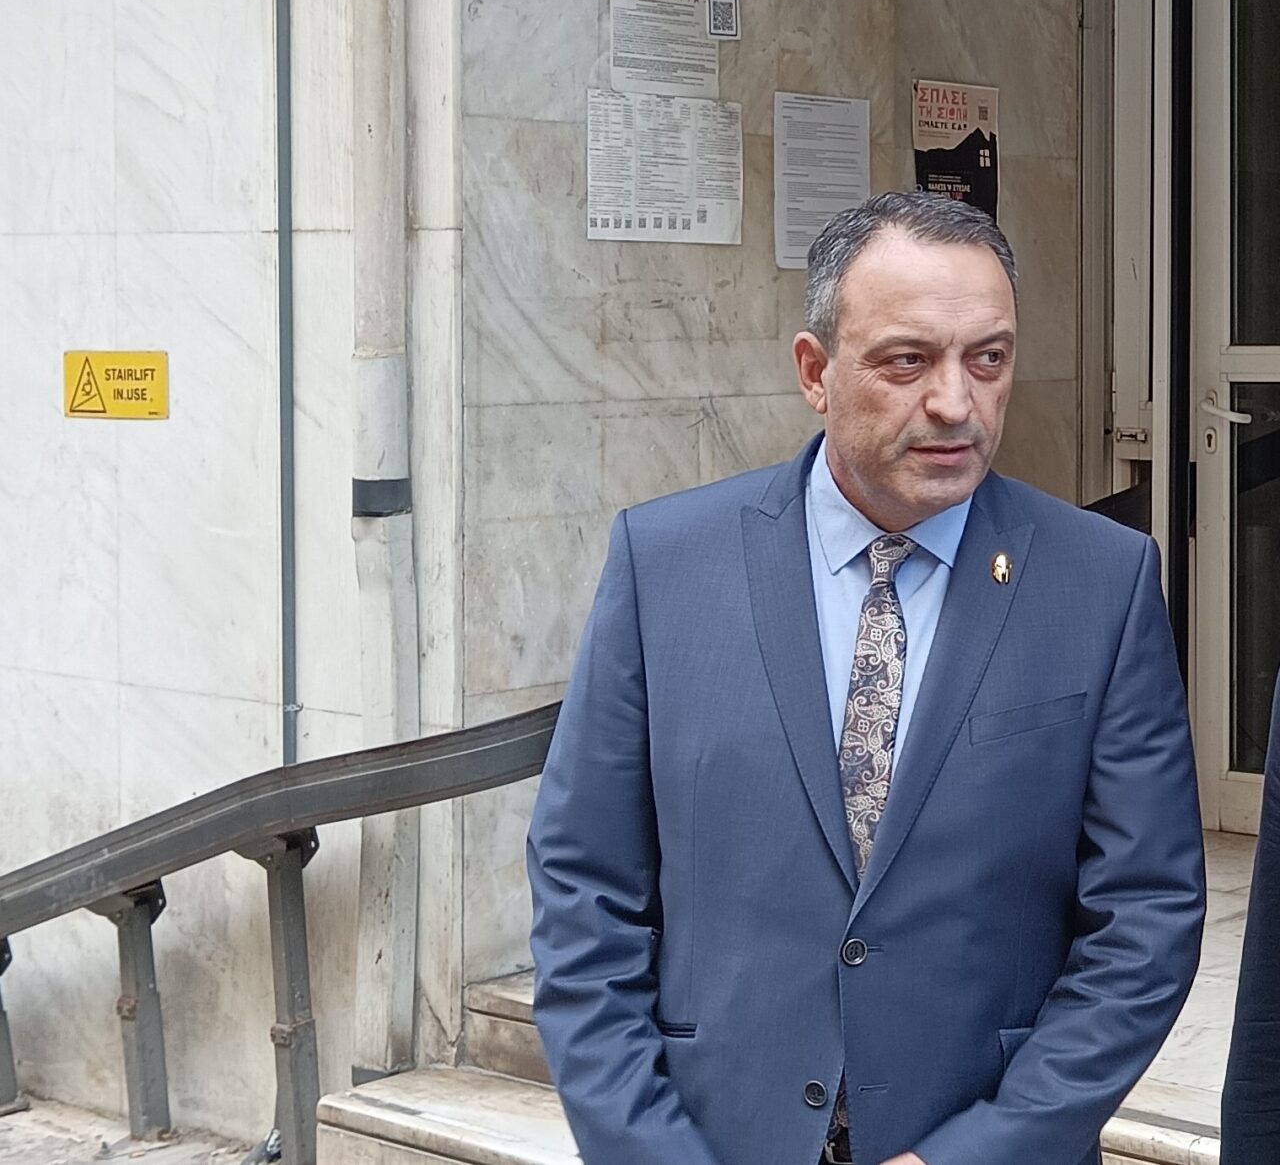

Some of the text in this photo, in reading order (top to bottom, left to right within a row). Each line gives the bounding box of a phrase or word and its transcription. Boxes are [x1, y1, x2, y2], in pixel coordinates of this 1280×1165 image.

[919, 87, 967, 105] ΣΠΑΣΕ
[918, 105, 932, 118] ΤΗ
[104, 368, 156, 381] STAIRLIFT
[126, 388, 147, 401] USE
